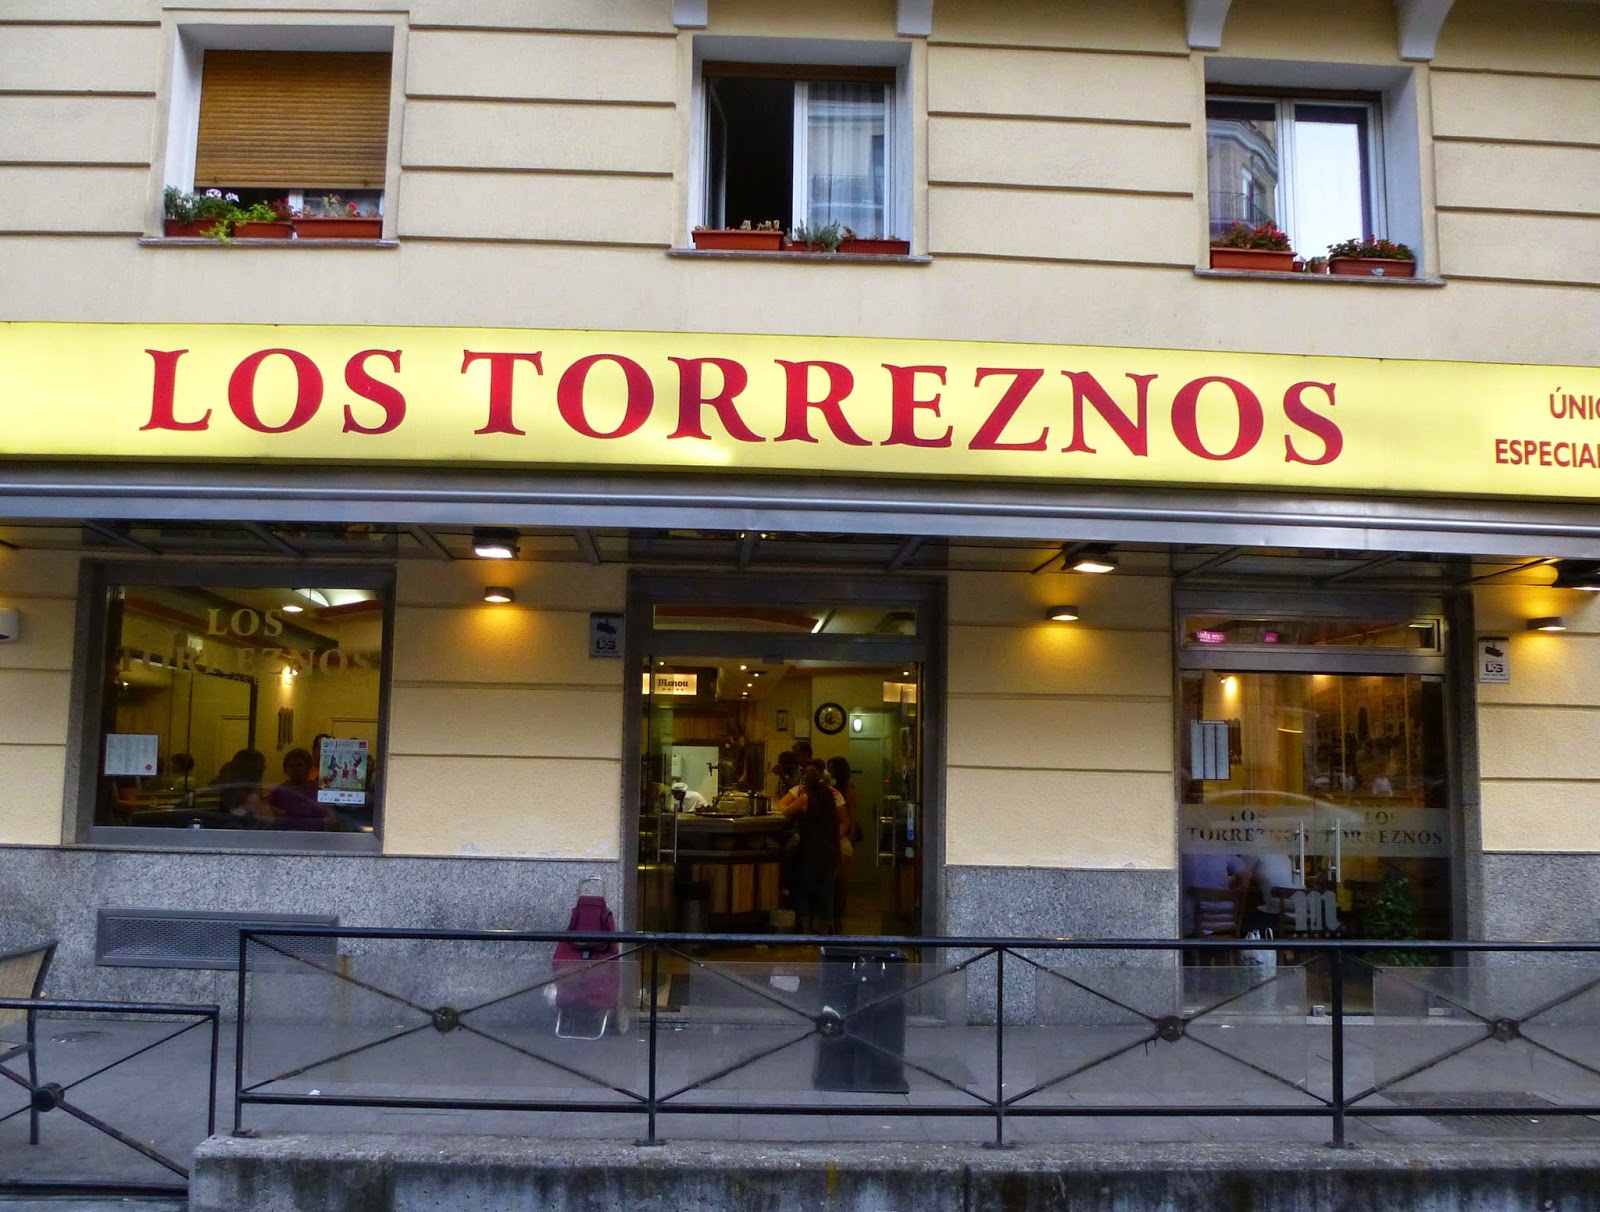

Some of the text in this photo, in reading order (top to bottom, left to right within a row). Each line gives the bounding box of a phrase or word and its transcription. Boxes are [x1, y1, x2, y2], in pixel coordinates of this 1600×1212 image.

[139, 347, 1344, 467] LOS TORREZNOS
[1495, 438, 1600, 468] ESPECIA
[206, 607, 284, 637] LOS
[120, 646, 376, 678] TOREZNOS
[1364, 811, 1399, 826] LO
[1186, 827, 1310, 842] TORREOS
[1321, 829, 1443, 845] TREZNOS
